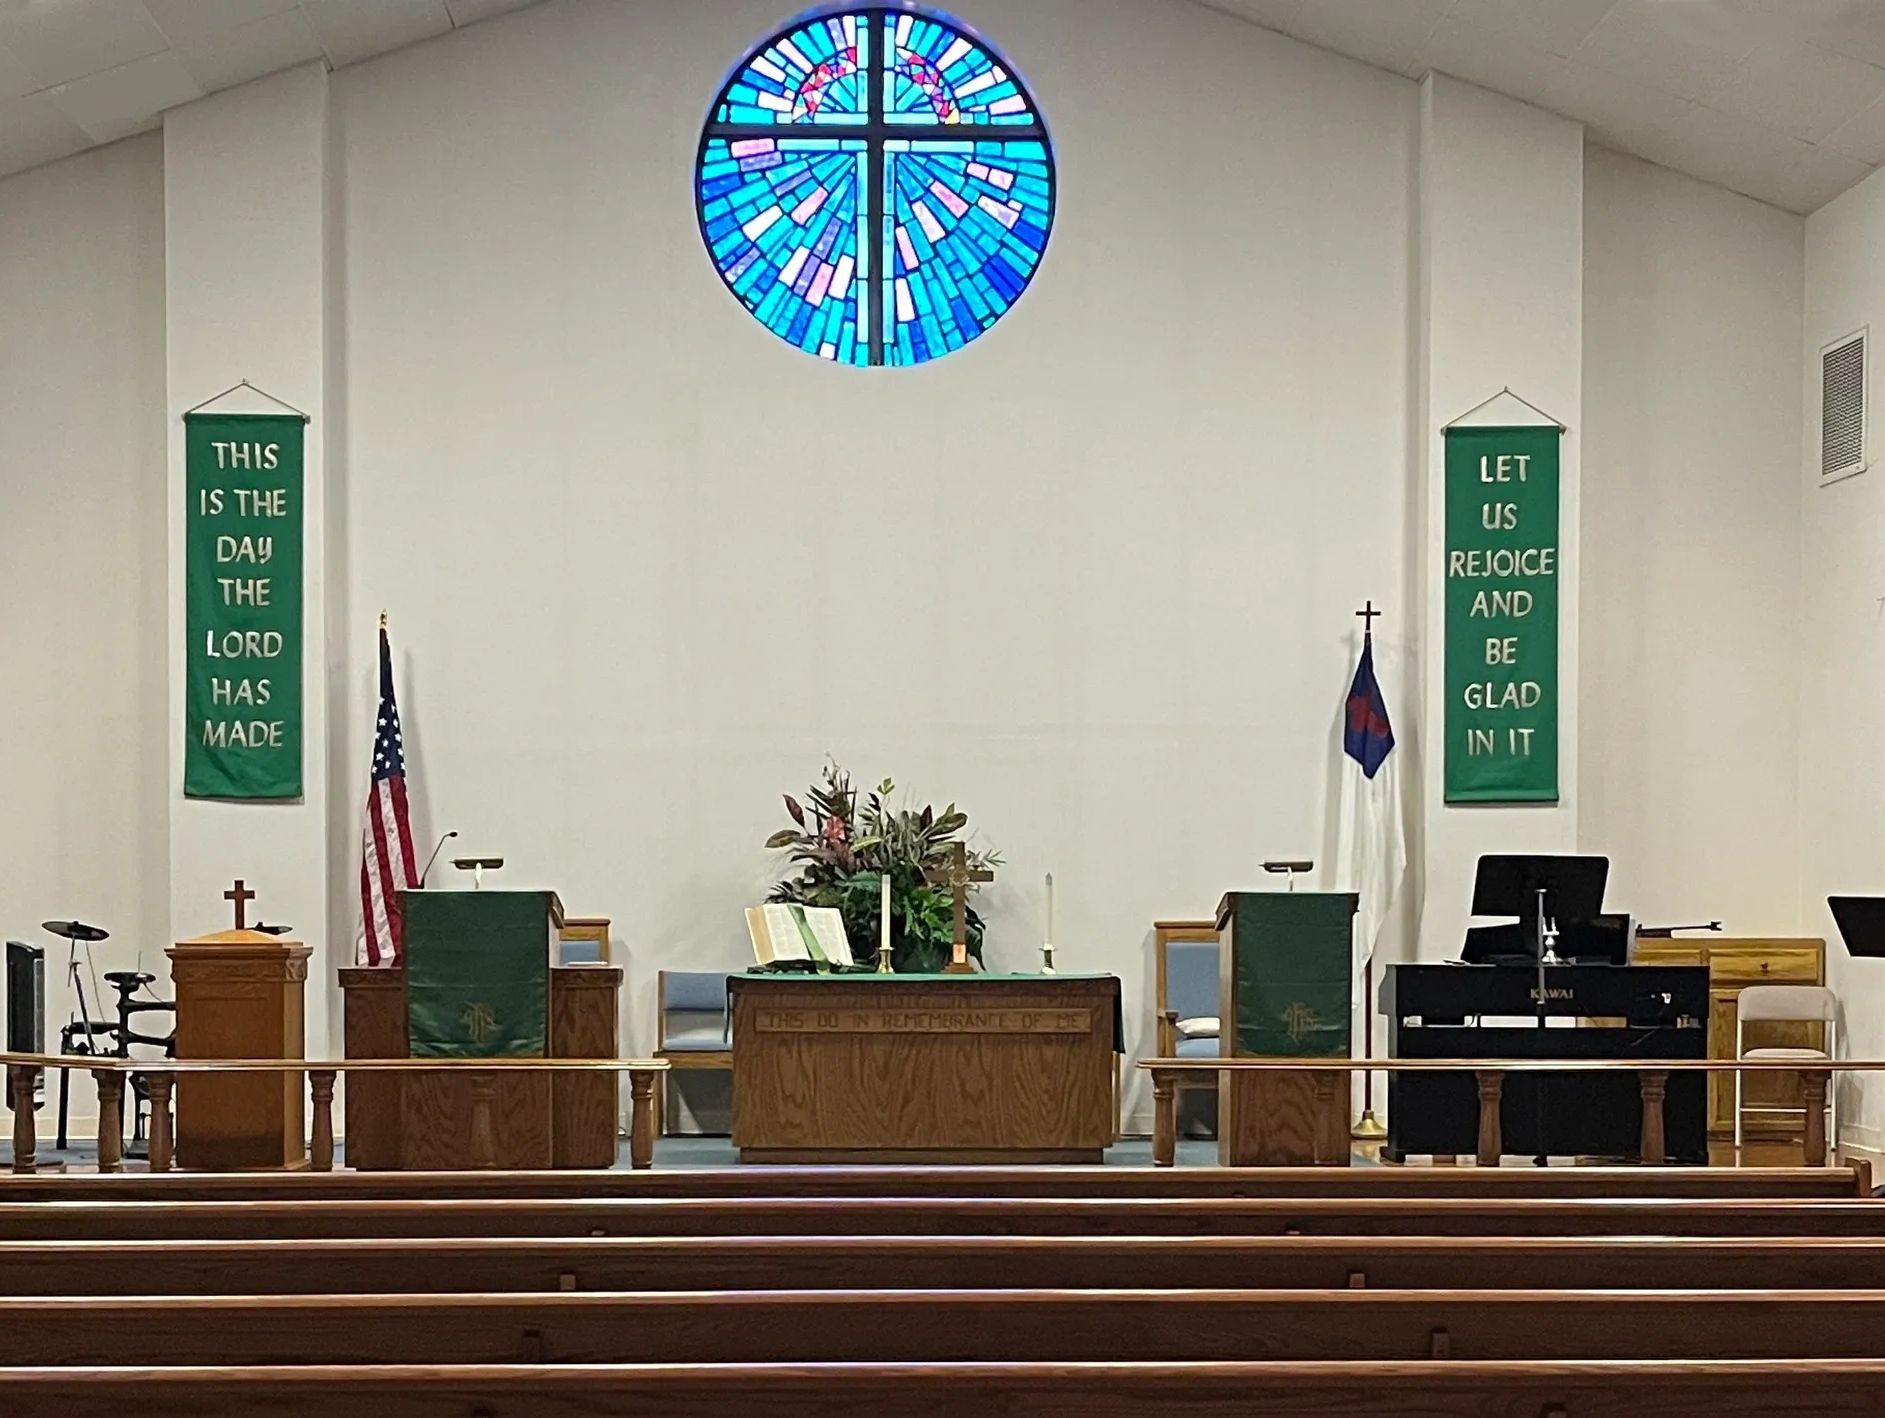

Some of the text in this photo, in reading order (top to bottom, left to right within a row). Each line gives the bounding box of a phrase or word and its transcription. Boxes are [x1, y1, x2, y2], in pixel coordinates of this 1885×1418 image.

[210, 441, 280, 470] THIS
[1480, 454, 1531, 483] LET
[200, 488, 287, 518] IS THE
[1482, 502, 1518, 530] US
[1449, 548, 1556, 578] REJOICE
[217, 577, 271, 606] THE
[1469, 590, 1533, 618] AND
[206, 629, 283, 658] LORD
[1485, 636, 1518, 665] BE
[211, 677, 272, 706] HAS
[1463, 681, 1542, 710] GLAD
[202, 719, 284, 748] MADE
[1467, 728, 1535, 756] IN IT
[766, 1011, 804, 1028] THIS
[817, 1012, 840, 1028] DO
[1022, 1012, 1042, 1029] OF
[1056, 1012, 1080, 1029] ME
